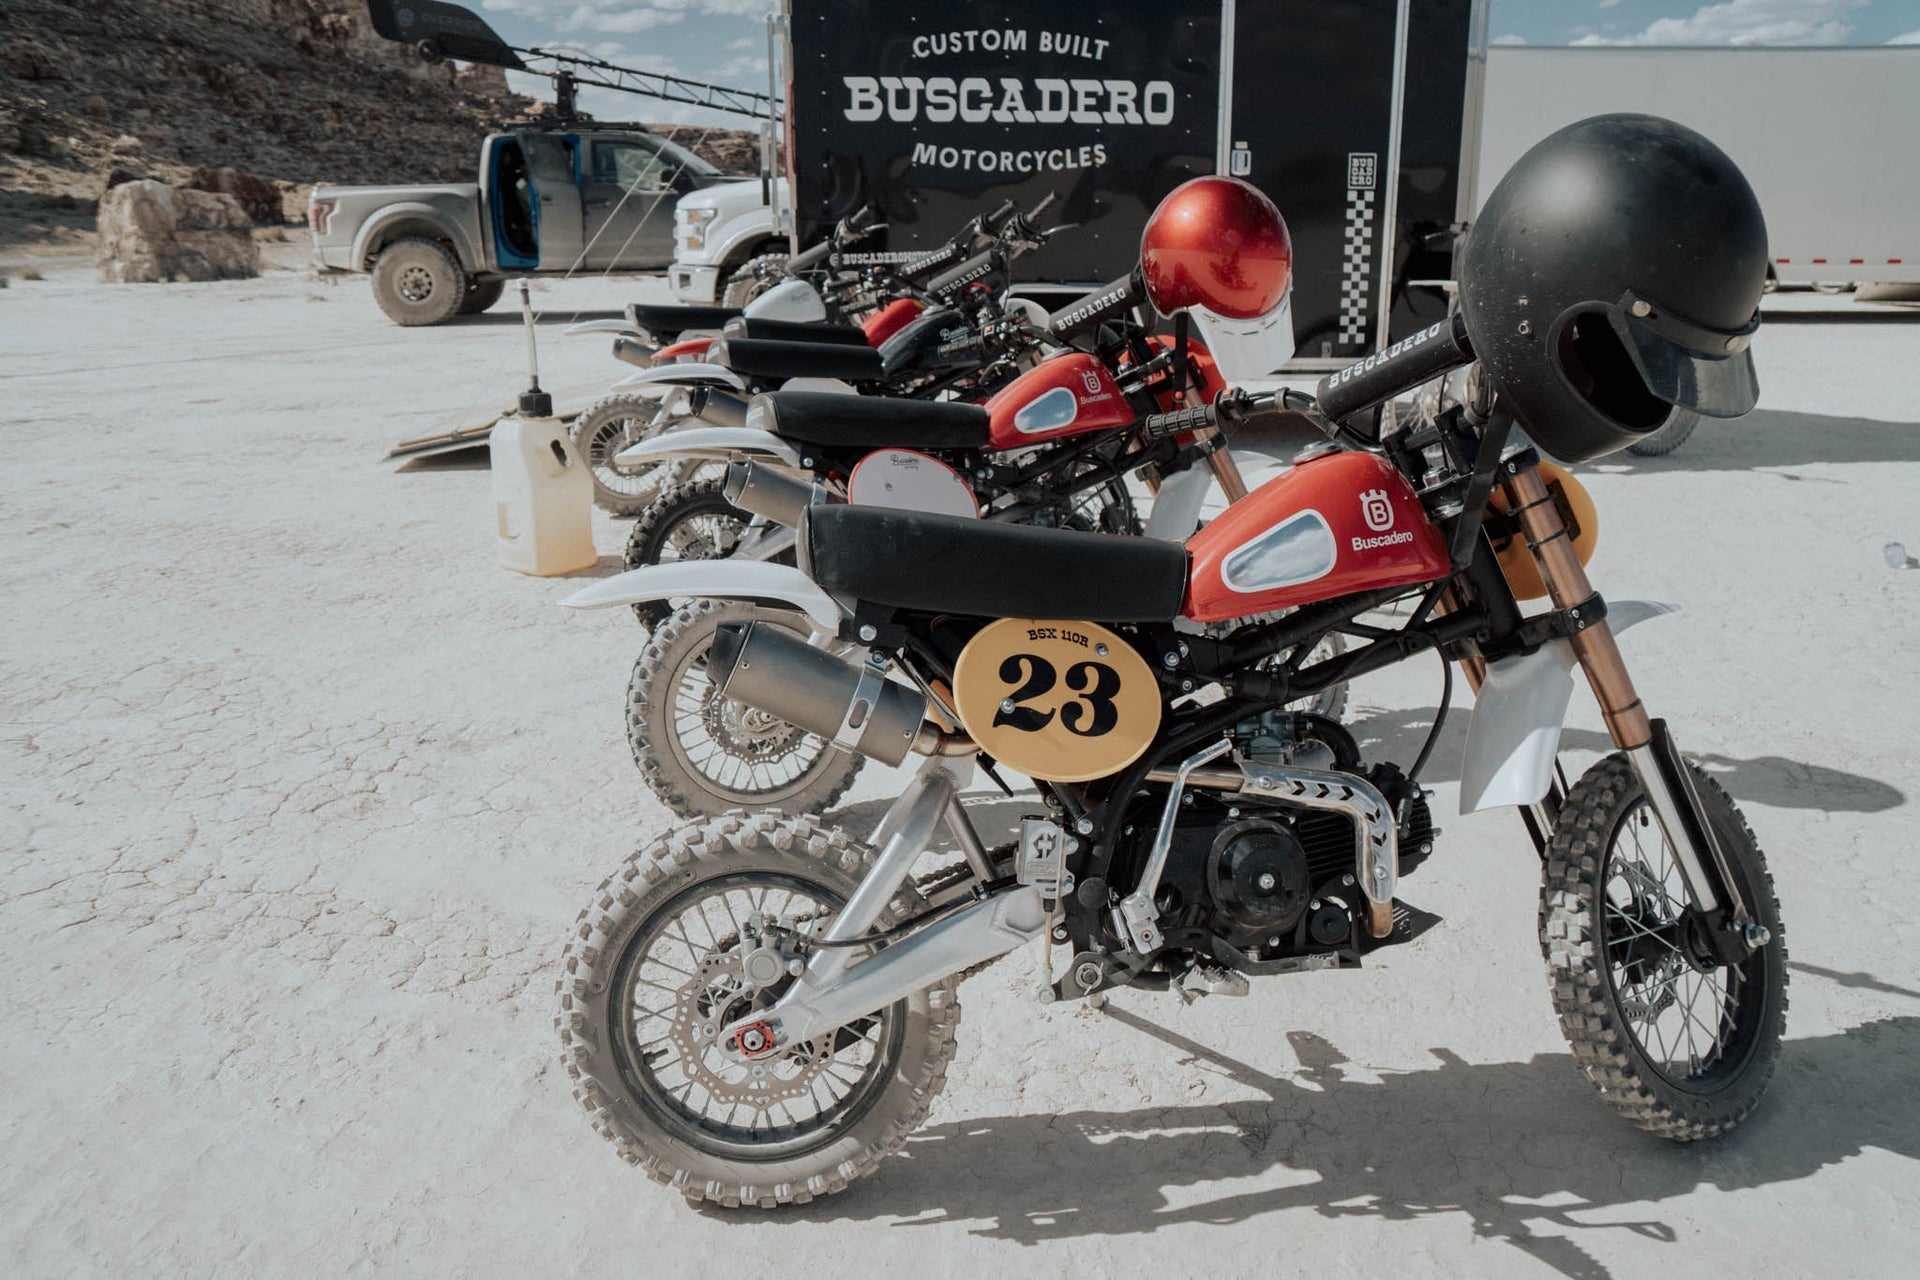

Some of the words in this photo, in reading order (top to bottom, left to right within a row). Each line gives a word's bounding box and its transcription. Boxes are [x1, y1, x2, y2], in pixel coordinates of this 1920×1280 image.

[912, 29, 1027, 59] CUSTOM
[1039, 30, 1109, 61] BUILT
[842, 76, 1175, 126] BUSCADERO
[911, 142, 1107, 172] MOTORCYCLES
[1352, 158, 1373, 167] BUS
[1351, 167, 1373, 176] CAD
[1351, 176, 1373, 185] ERO
[905, 249, 952, 275] BUSCADERO
[937, 263, 992, 297] BUSCADERO
[1056, 286, 1128, 332] BUSCADERO
[1328, 322, 1441, 388] BUSCADERO
[1370, 502, 1387, 523] B
[1352, 531, 1413, 551] Buscadero
[1027, 628, 1057, 641] BSX
[992, 653, 1122, 737] 23
